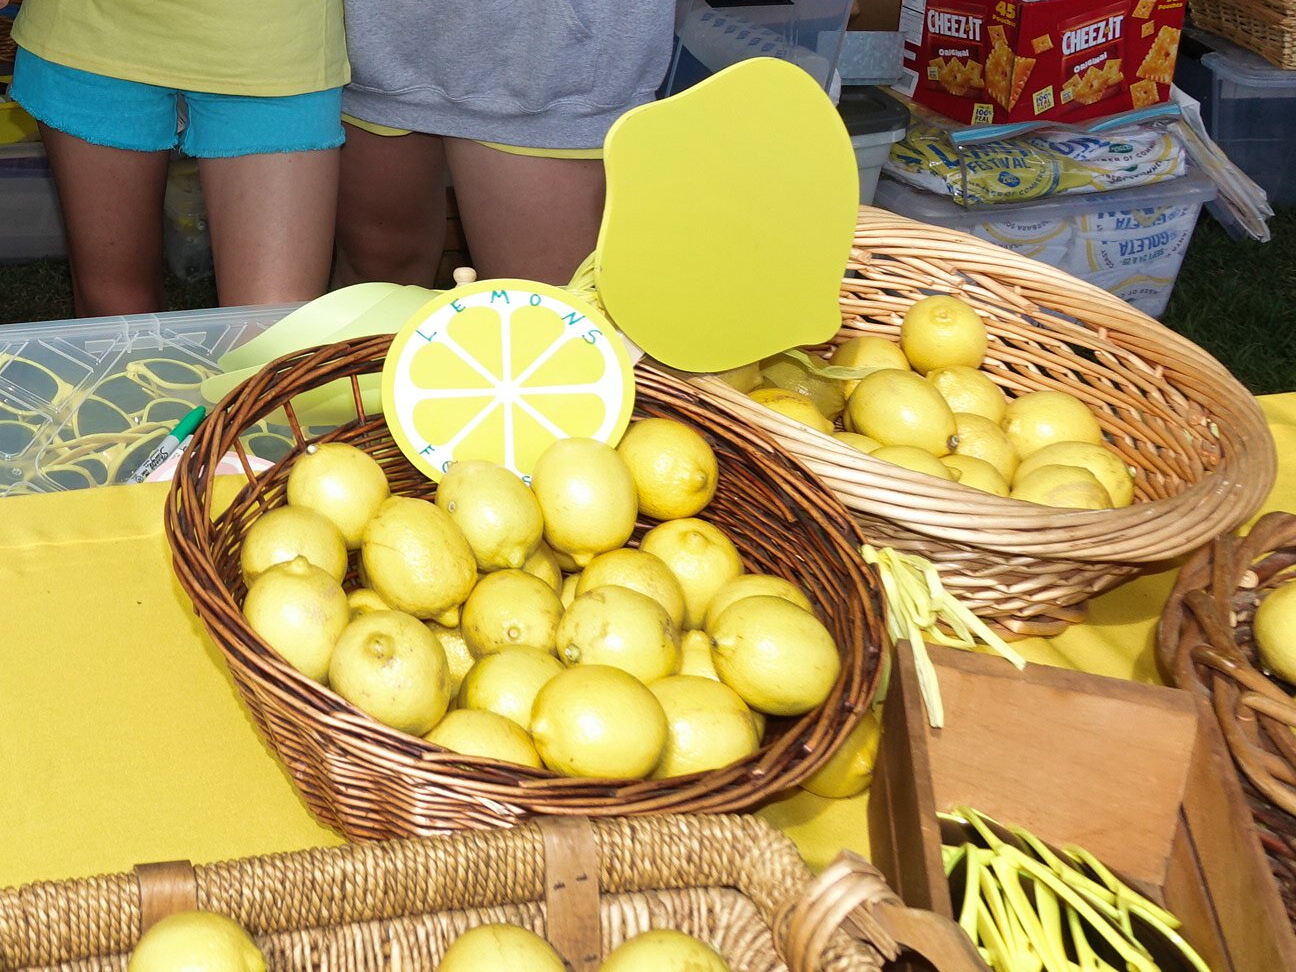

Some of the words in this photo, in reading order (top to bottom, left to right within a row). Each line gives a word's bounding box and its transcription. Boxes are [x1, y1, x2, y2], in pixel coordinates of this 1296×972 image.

[995, 0, 1016, 20] 45
[1119, 231, 1170, 257] GOLETA
[415, 289, 603, 346] LEMONS
